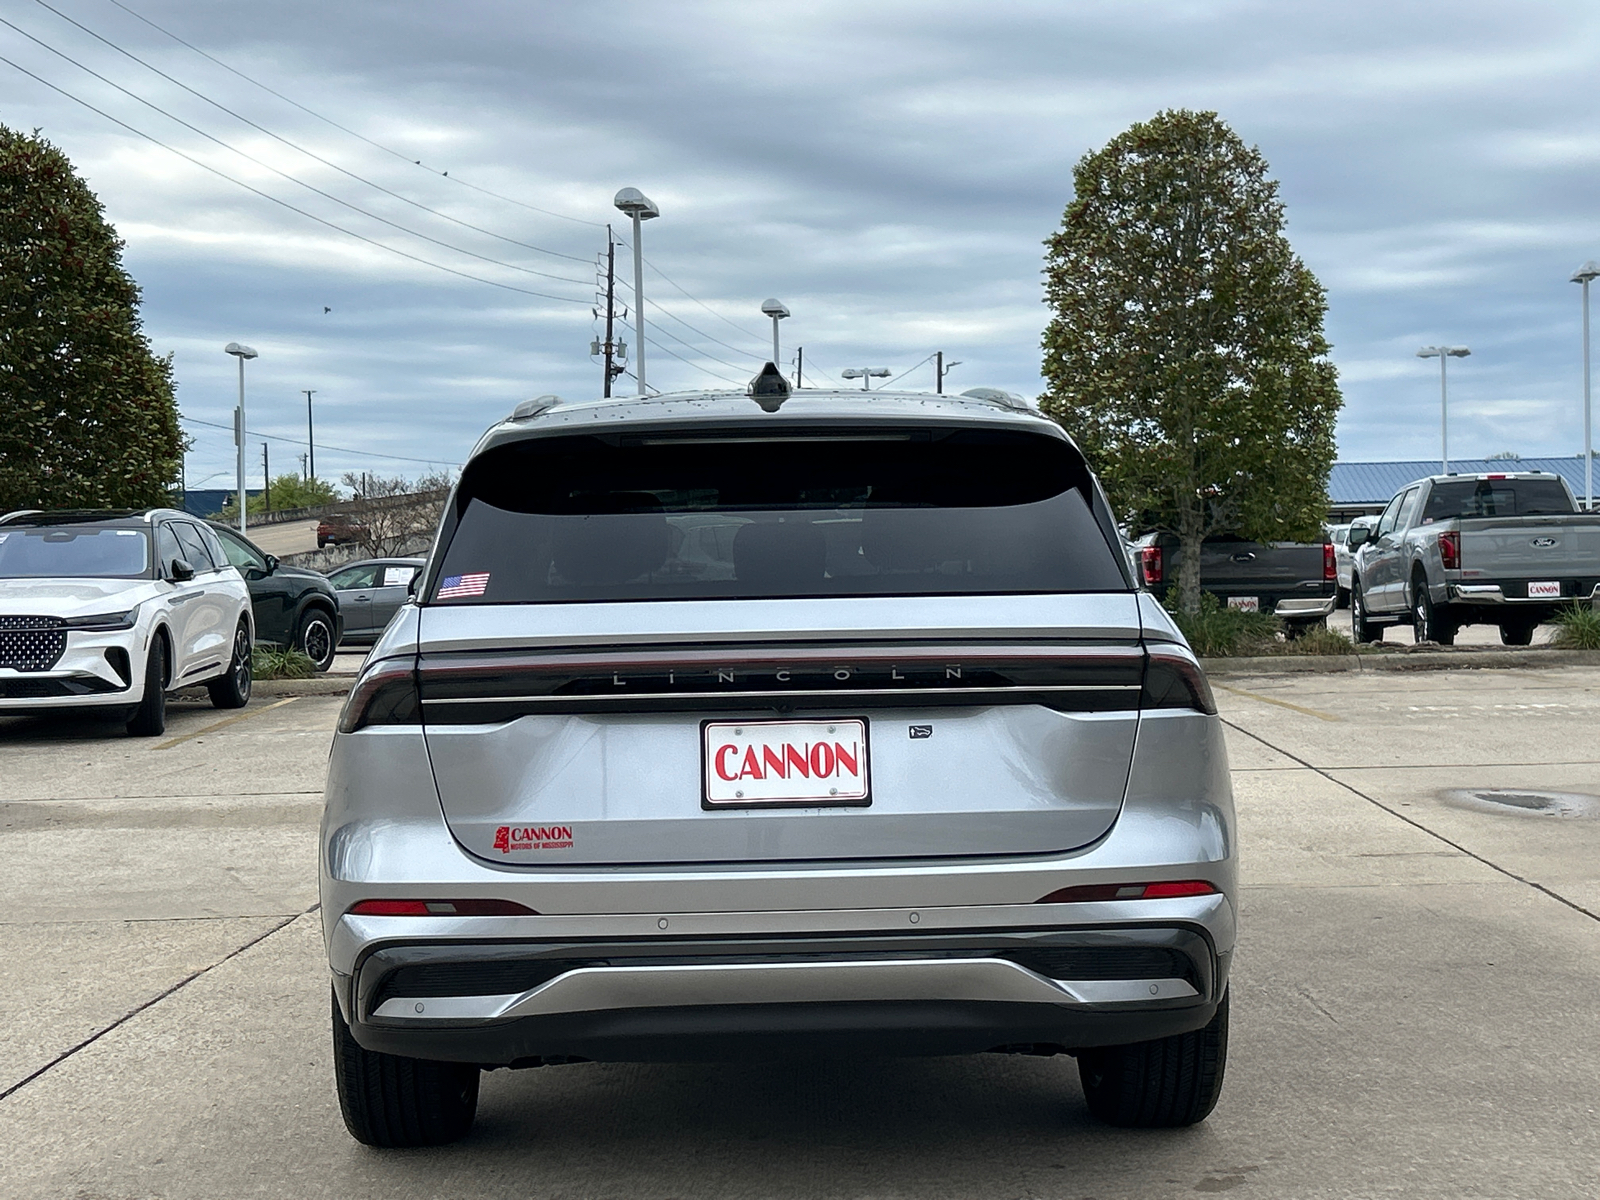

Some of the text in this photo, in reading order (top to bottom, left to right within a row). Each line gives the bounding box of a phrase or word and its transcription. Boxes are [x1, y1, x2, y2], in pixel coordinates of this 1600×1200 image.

[1530, 586, 1558, 594] CANNON
[613, 666, 962, 686] LINCOLN
[715, 741, 858, 781] CANNON
[511, 826, 572, 841] CANNON
[542, 841, 573, 849] MISSISSIPPI
